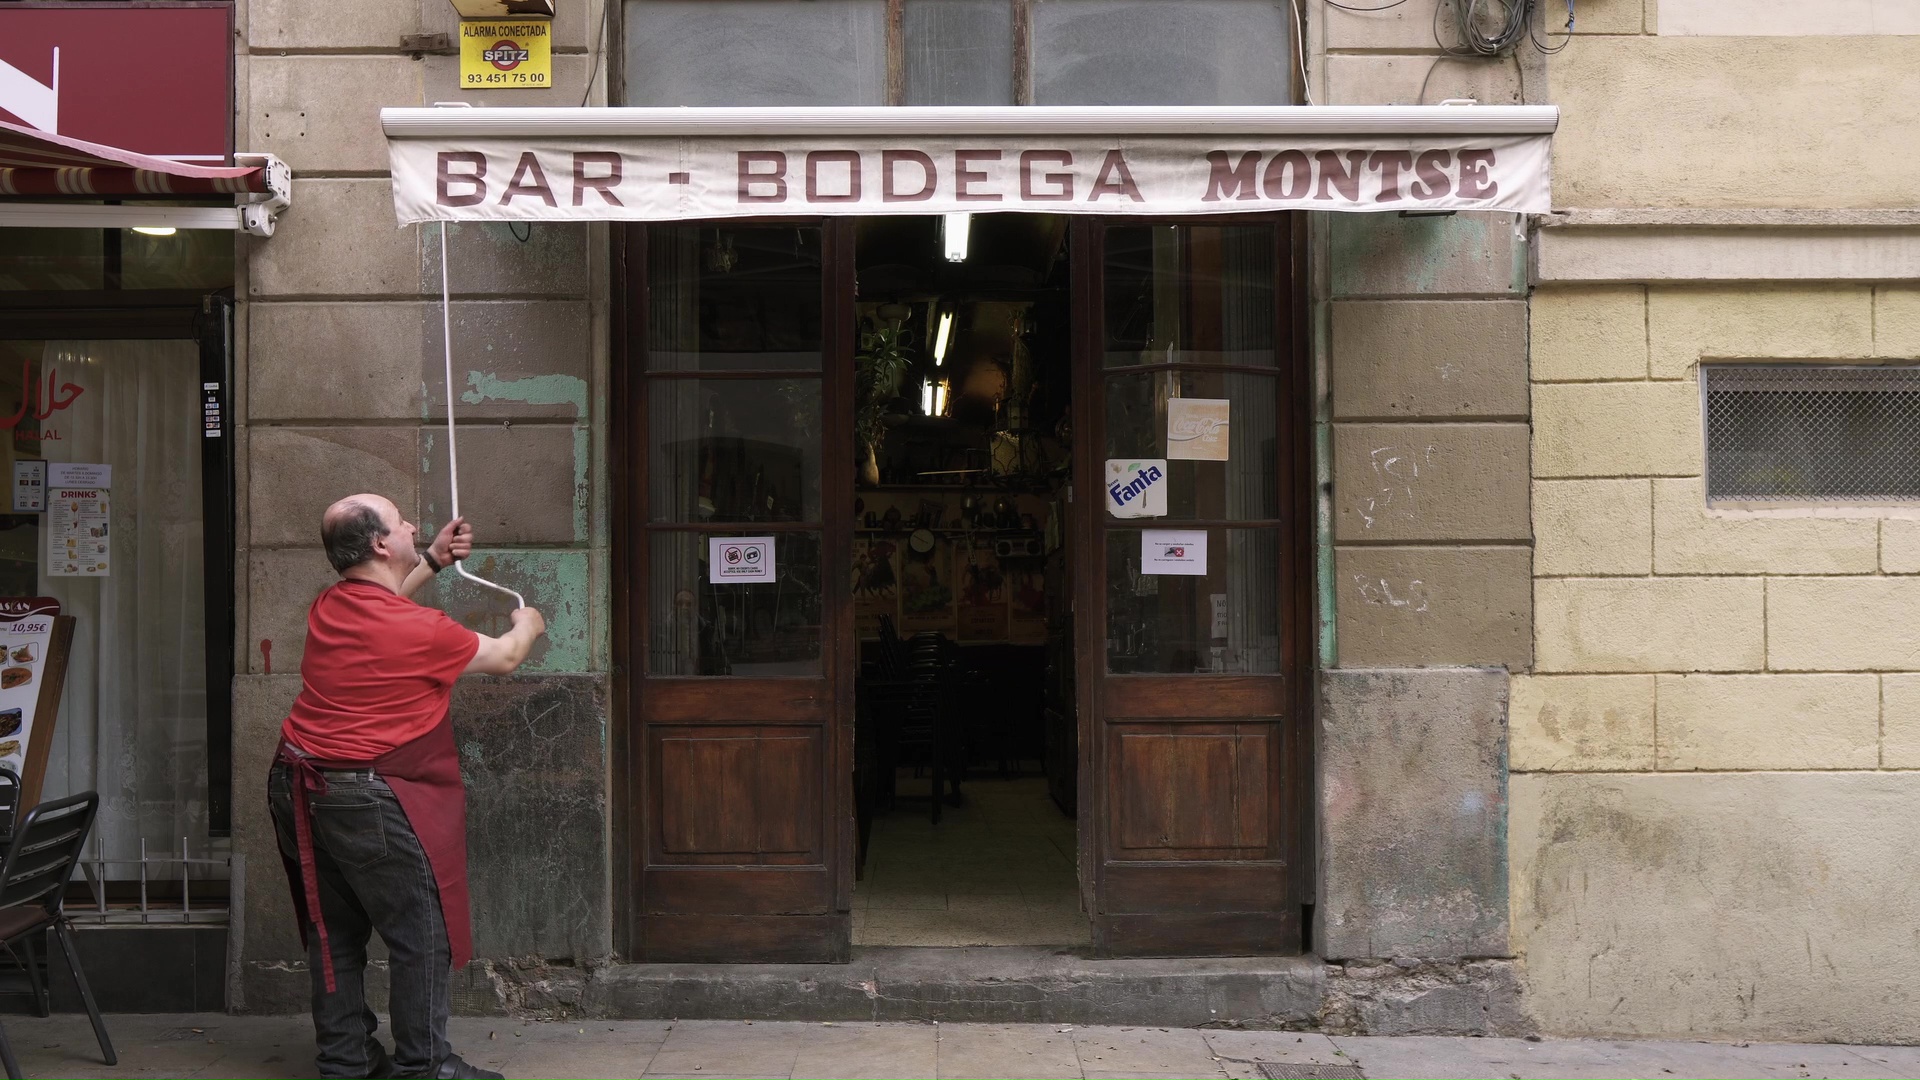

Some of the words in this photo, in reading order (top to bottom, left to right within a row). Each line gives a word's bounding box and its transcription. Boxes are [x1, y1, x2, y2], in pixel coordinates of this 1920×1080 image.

[464, 26, 497, 37] ALARMA
[498, 25, 547, 37] CONECTADA
[484, 50, 528, 61] SPITZ
[467, 74, 482, 83] 93
[486, 73, 507, 83] 451
[512, 73, 526, 83] 75
[530, 73, 545, 82] 00
[436, 151, 625, 208] BAR
[737, 149, 1146, 204] BODEGA
[1201, 148, 1498, 203] MONTSE
[15, 429, 62, 441] HALAL
[1109, 465, 1163, 506] Fanta
[61, 490, 97, 499] DRINKS
[11, 623, 46, 634] 10,95€
